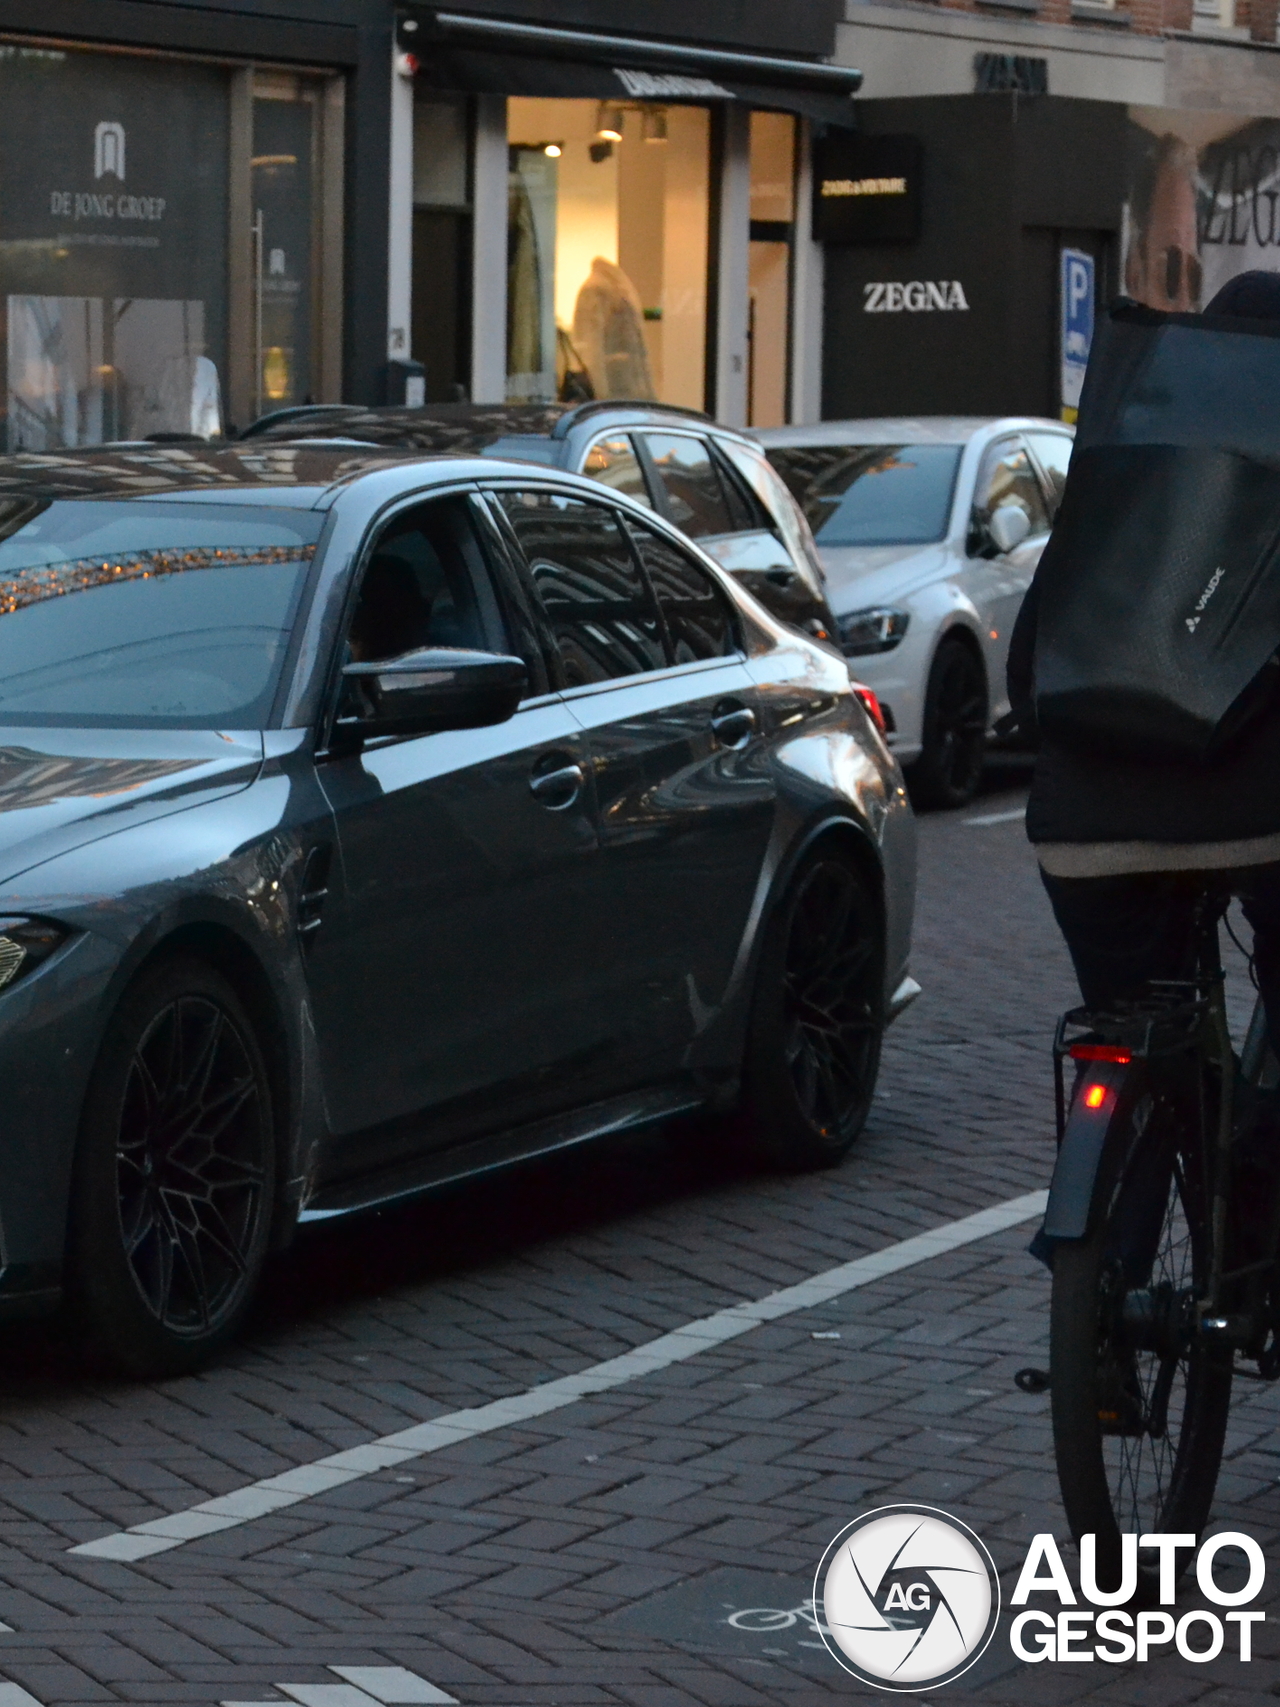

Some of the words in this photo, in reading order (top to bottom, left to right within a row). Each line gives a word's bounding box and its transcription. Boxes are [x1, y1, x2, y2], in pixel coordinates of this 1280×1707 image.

[50, 191, 72, 215] DE
[74, 192, 114, 221] JONG
[116, 194, 166, 220] GROEP
[1198, 148, 1280, 247] ZEG
[863, 280, 970, 312] ZEGNA
[1071, 261, 1088, 319] P
[1195, 566, 1226, 611] VAUDE
